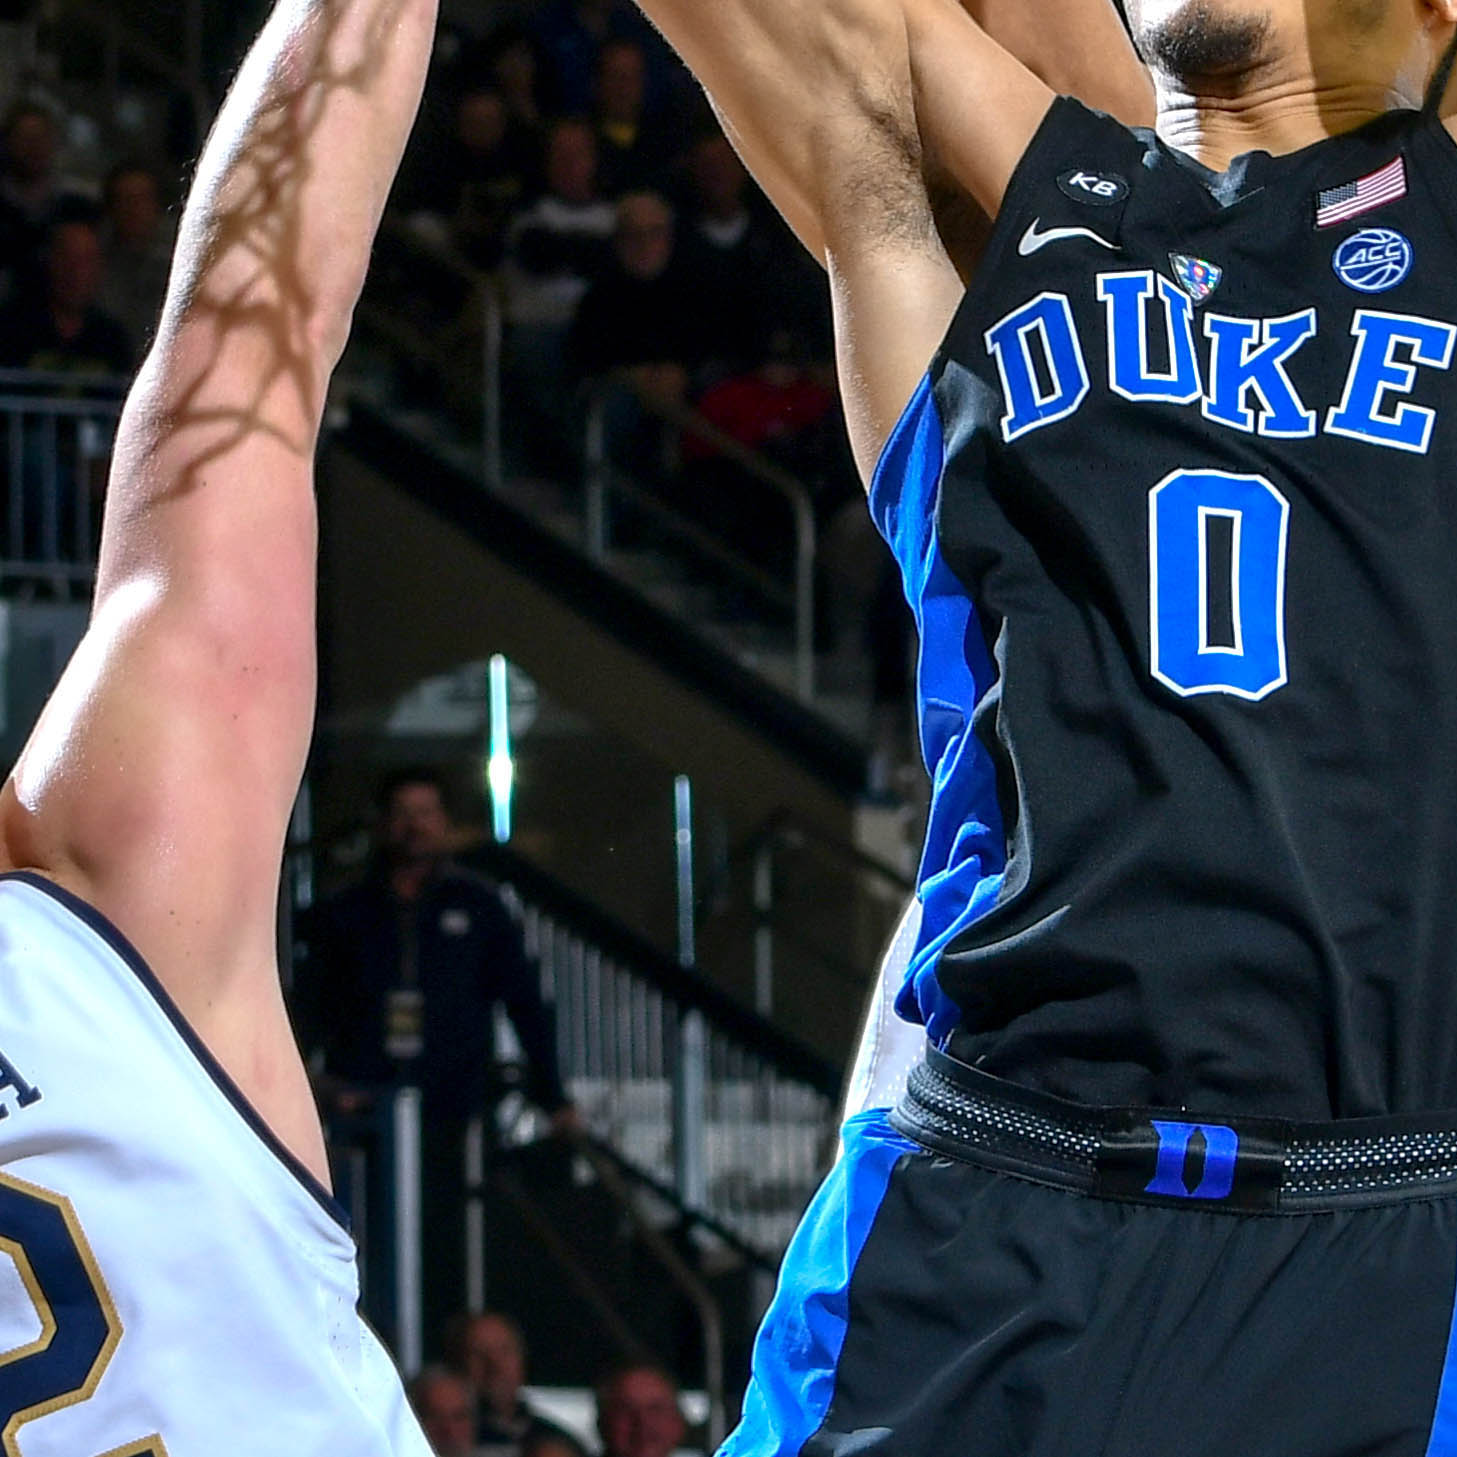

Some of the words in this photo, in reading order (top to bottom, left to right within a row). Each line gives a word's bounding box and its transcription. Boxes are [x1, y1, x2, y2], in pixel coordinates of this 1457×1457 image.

[1068, 171, 1118, 196] KB
[1344, 241, 1402, 265] ACC
[1148, 468, 1290, 701] 0
